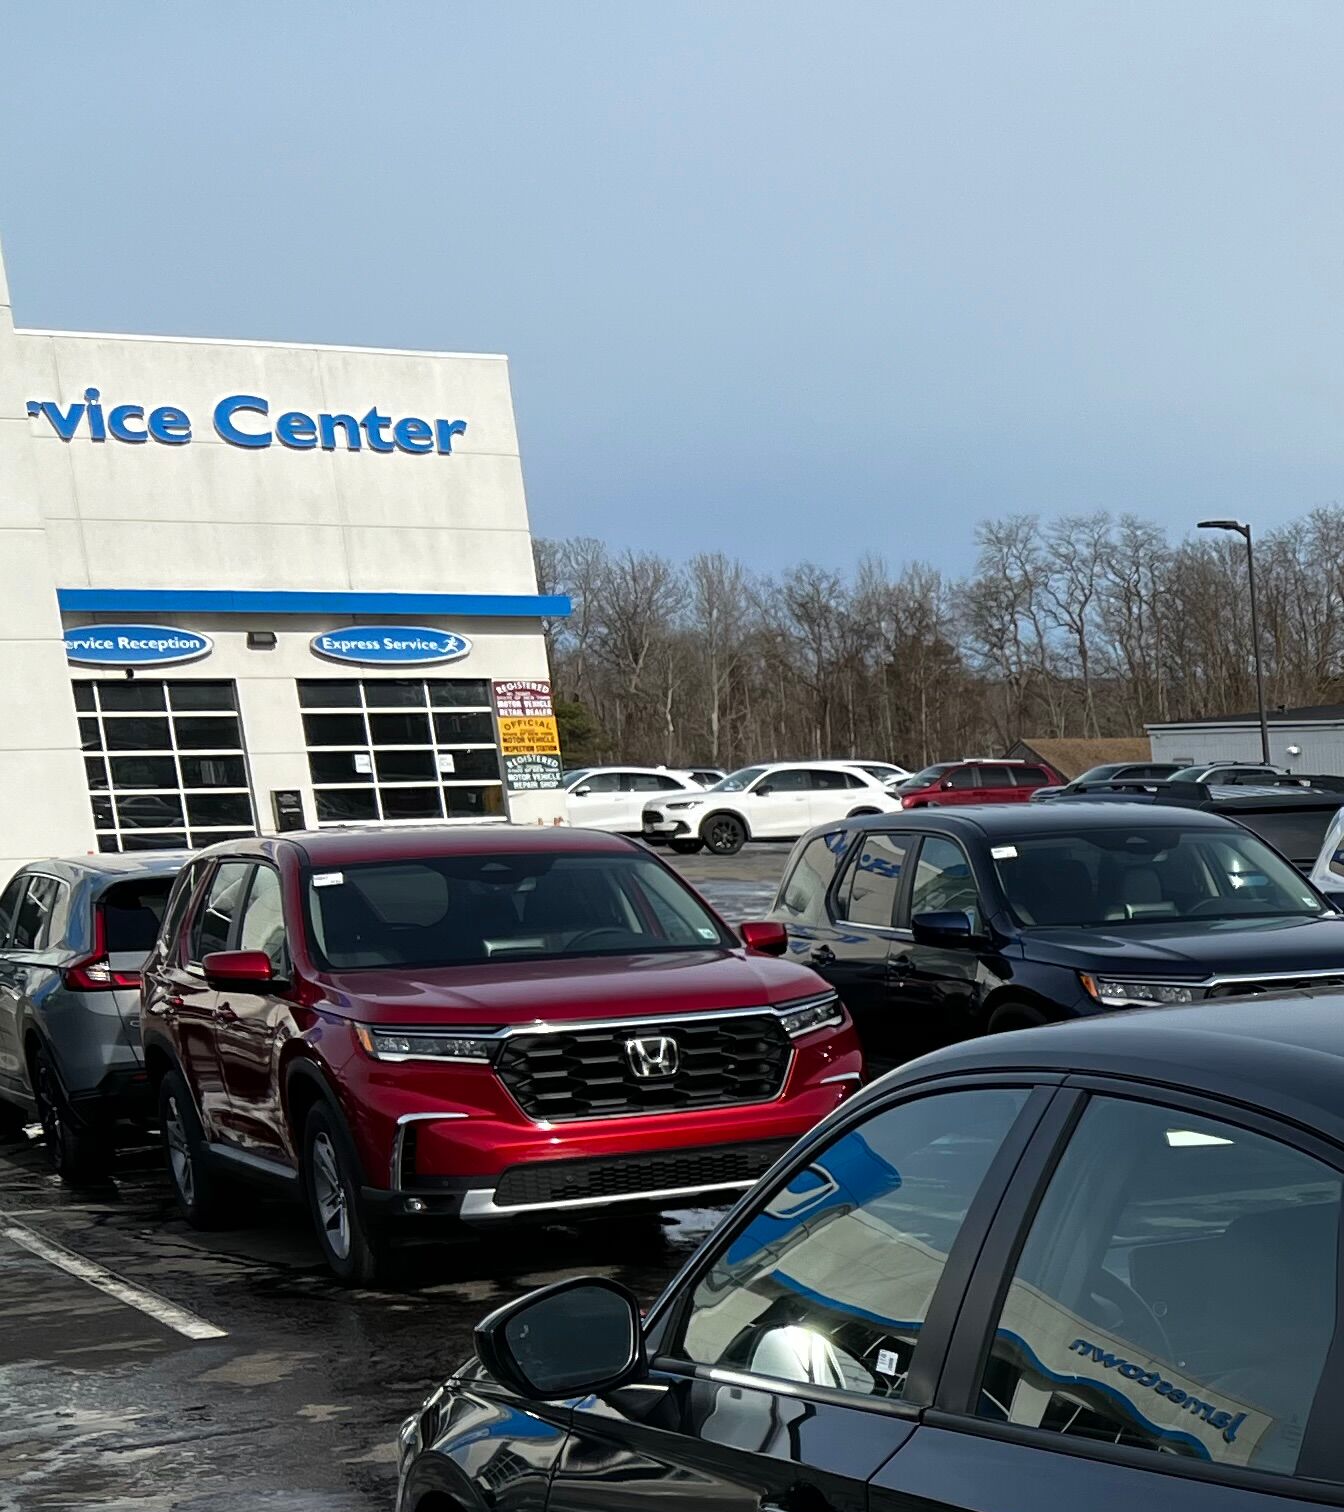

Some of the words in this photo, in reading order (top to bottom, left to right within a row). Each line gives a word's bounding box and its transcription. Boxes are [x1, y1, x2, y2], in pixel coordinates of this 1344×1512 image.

[213, 394, 467, 455] Center
[118, 637, 200, 652] Reception
[322, 637, 380, 652] Express
[383, 637, 438, 650] Service
[495, 681, 550, 694] REGISTERED
[497, 700, 522, 708] MOTOR
[524, 700, 552, 708] VEHICLE
[525, 708, 552, 716] DEALER
[504, 719, 552, 730] OFFICIAL
[506, 755, 559, 768] REGISTERED
[507, 773, 531, 781] MOTOR
[533, 772, 561, 781] VEHICLE
[513, 781, 538, 789] REPAIR
